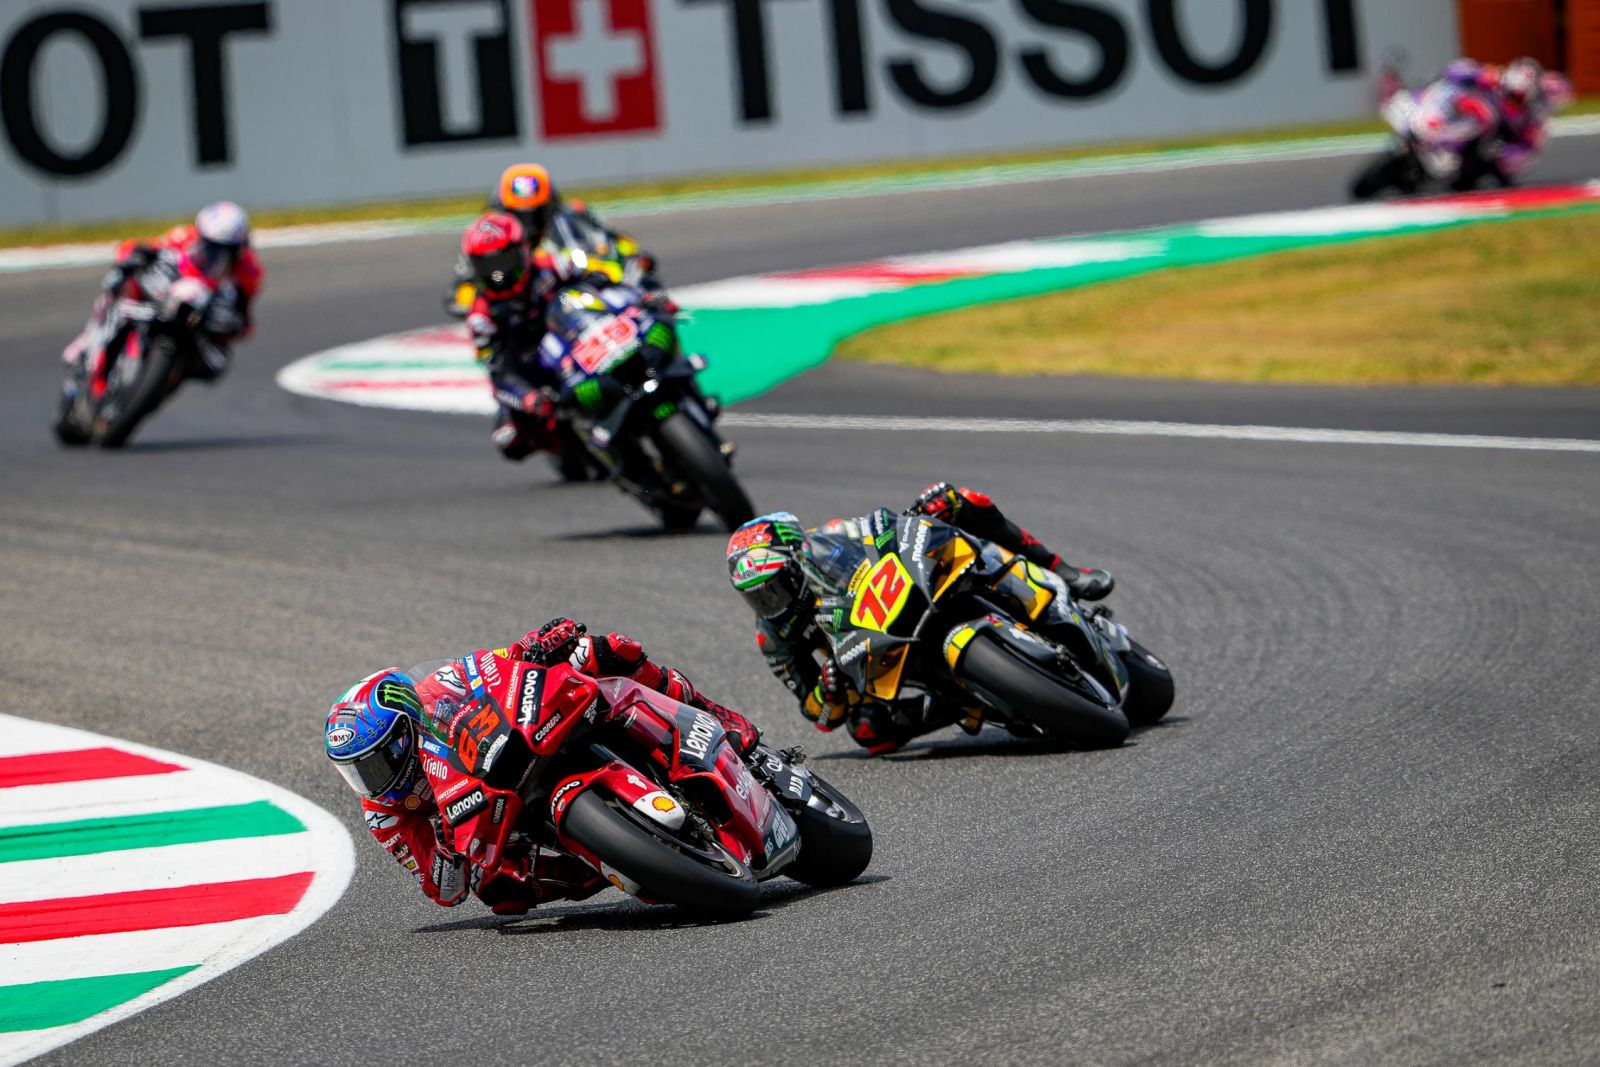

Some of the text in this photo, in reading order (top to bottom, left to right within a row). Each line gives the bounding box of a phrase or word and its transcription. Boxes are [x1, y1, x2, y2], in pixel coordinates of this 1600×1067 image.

[857, 558, 906, 630] 72
[517, 670, 538, 727] Lenovo
[458, 703, 501, 774] 63
[535, 712, 562, 741] CARRERA
[680, 713, 718, 760] Lenovo
[446, 790, 483, 820] Lenovo
